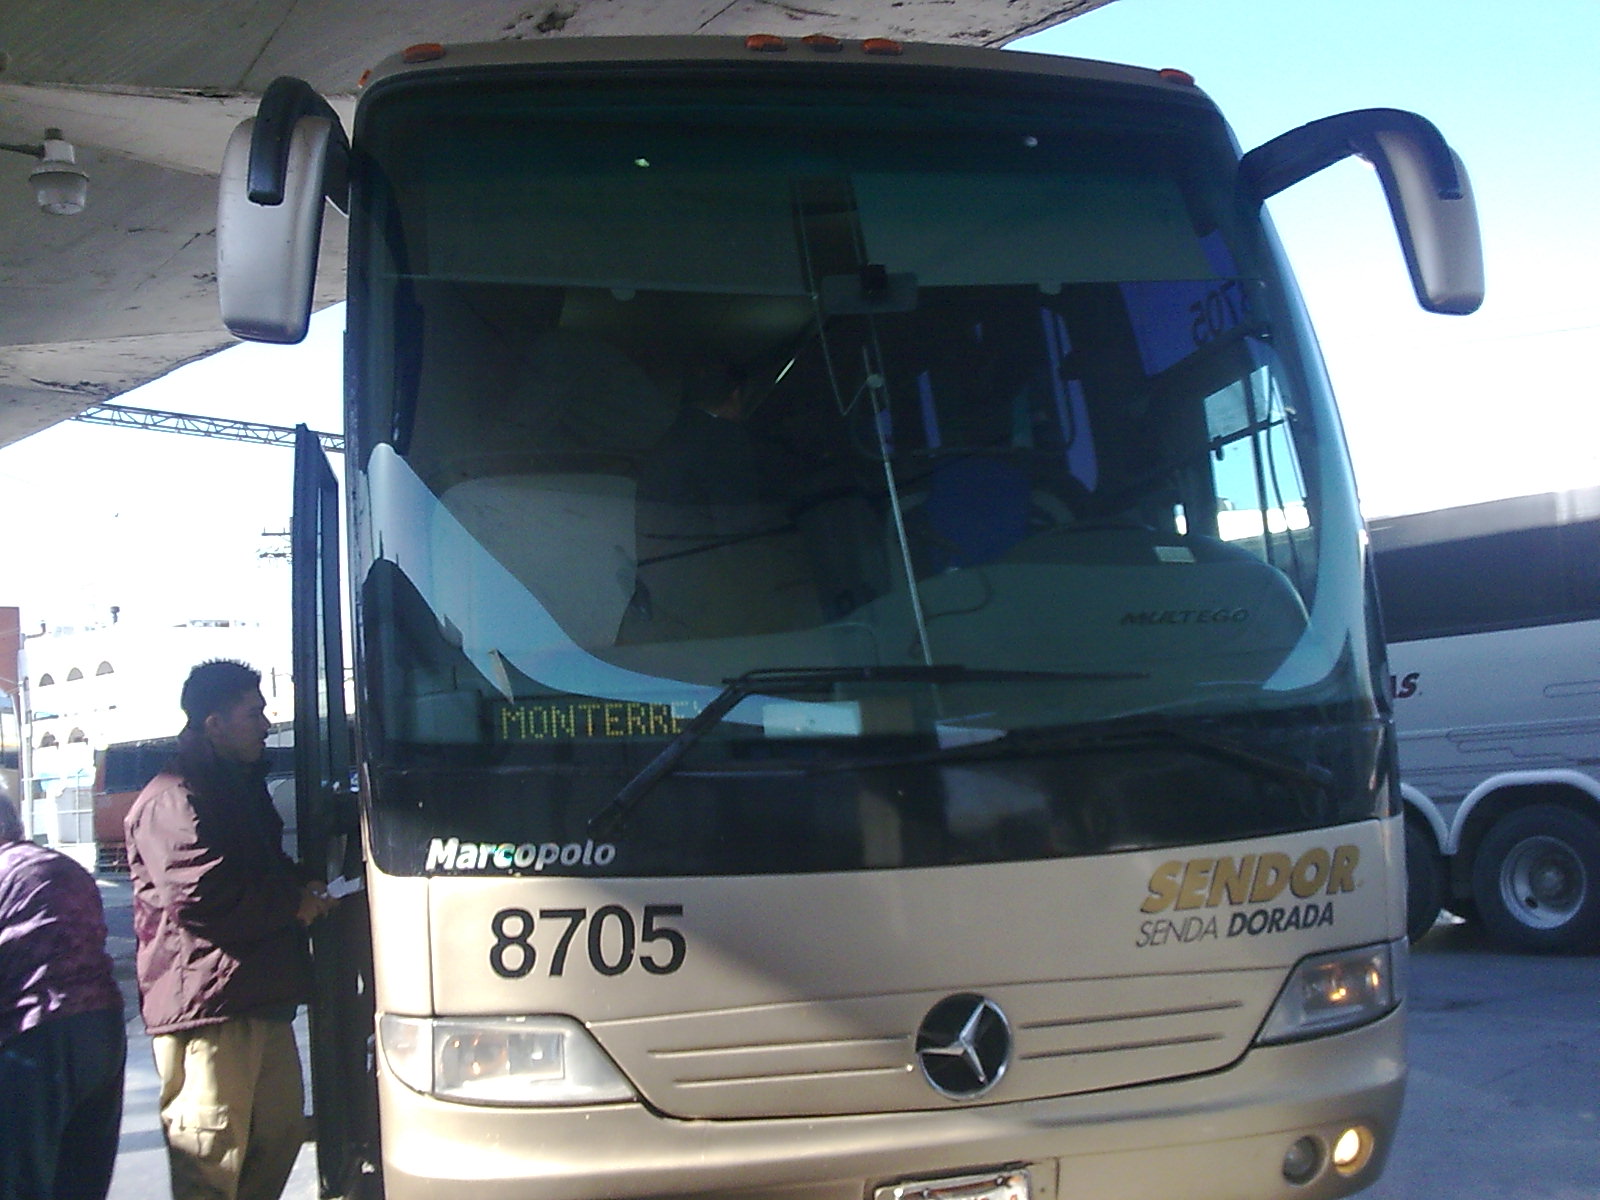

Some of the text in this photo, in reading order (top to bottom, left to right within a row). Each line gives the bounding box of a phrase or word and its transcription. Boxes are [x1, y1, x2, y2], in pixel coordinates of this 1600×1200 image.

[501, 702, 702, 740] MONTERRE
[425, 837, 617, 872] Marcopolo
[1140, 844, 1361, 914] SENDOR
[489, 903, 687, 979] 8705
[1136, 902, 1334, 948] SENDA DORADA
